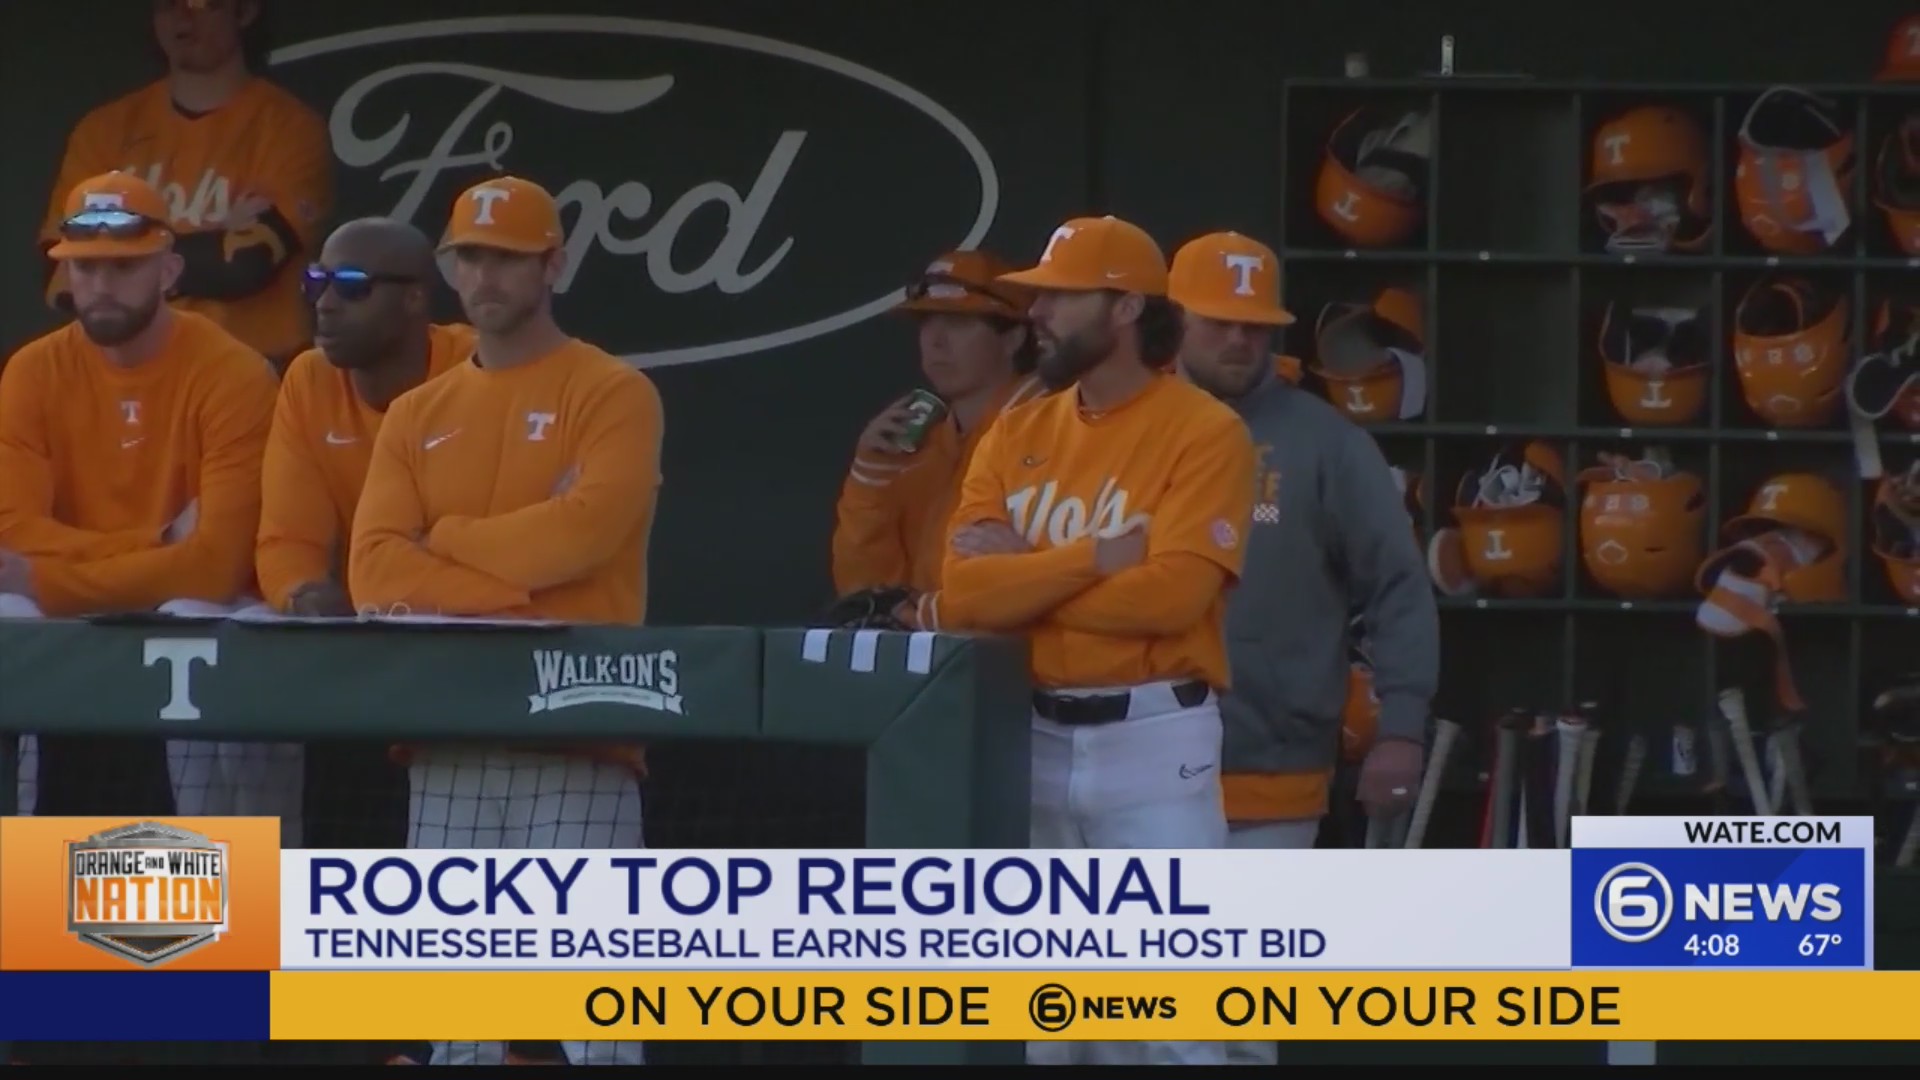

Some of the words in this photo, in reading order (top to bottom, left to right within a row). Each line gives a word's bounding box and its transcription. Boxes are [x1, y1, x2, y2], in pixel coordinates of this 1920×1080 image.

[1604, 134, 1631, 165] T
[329, 62, 807, 293] Frd
[472, 189, 510, 225] T
[1226, 254, 1264, 296] T
[120, 400, 142, 424] T
[526, 411, 558, 441] T
[1761, 484, 1788, 511] T
[143, 637, 218, 721] T
